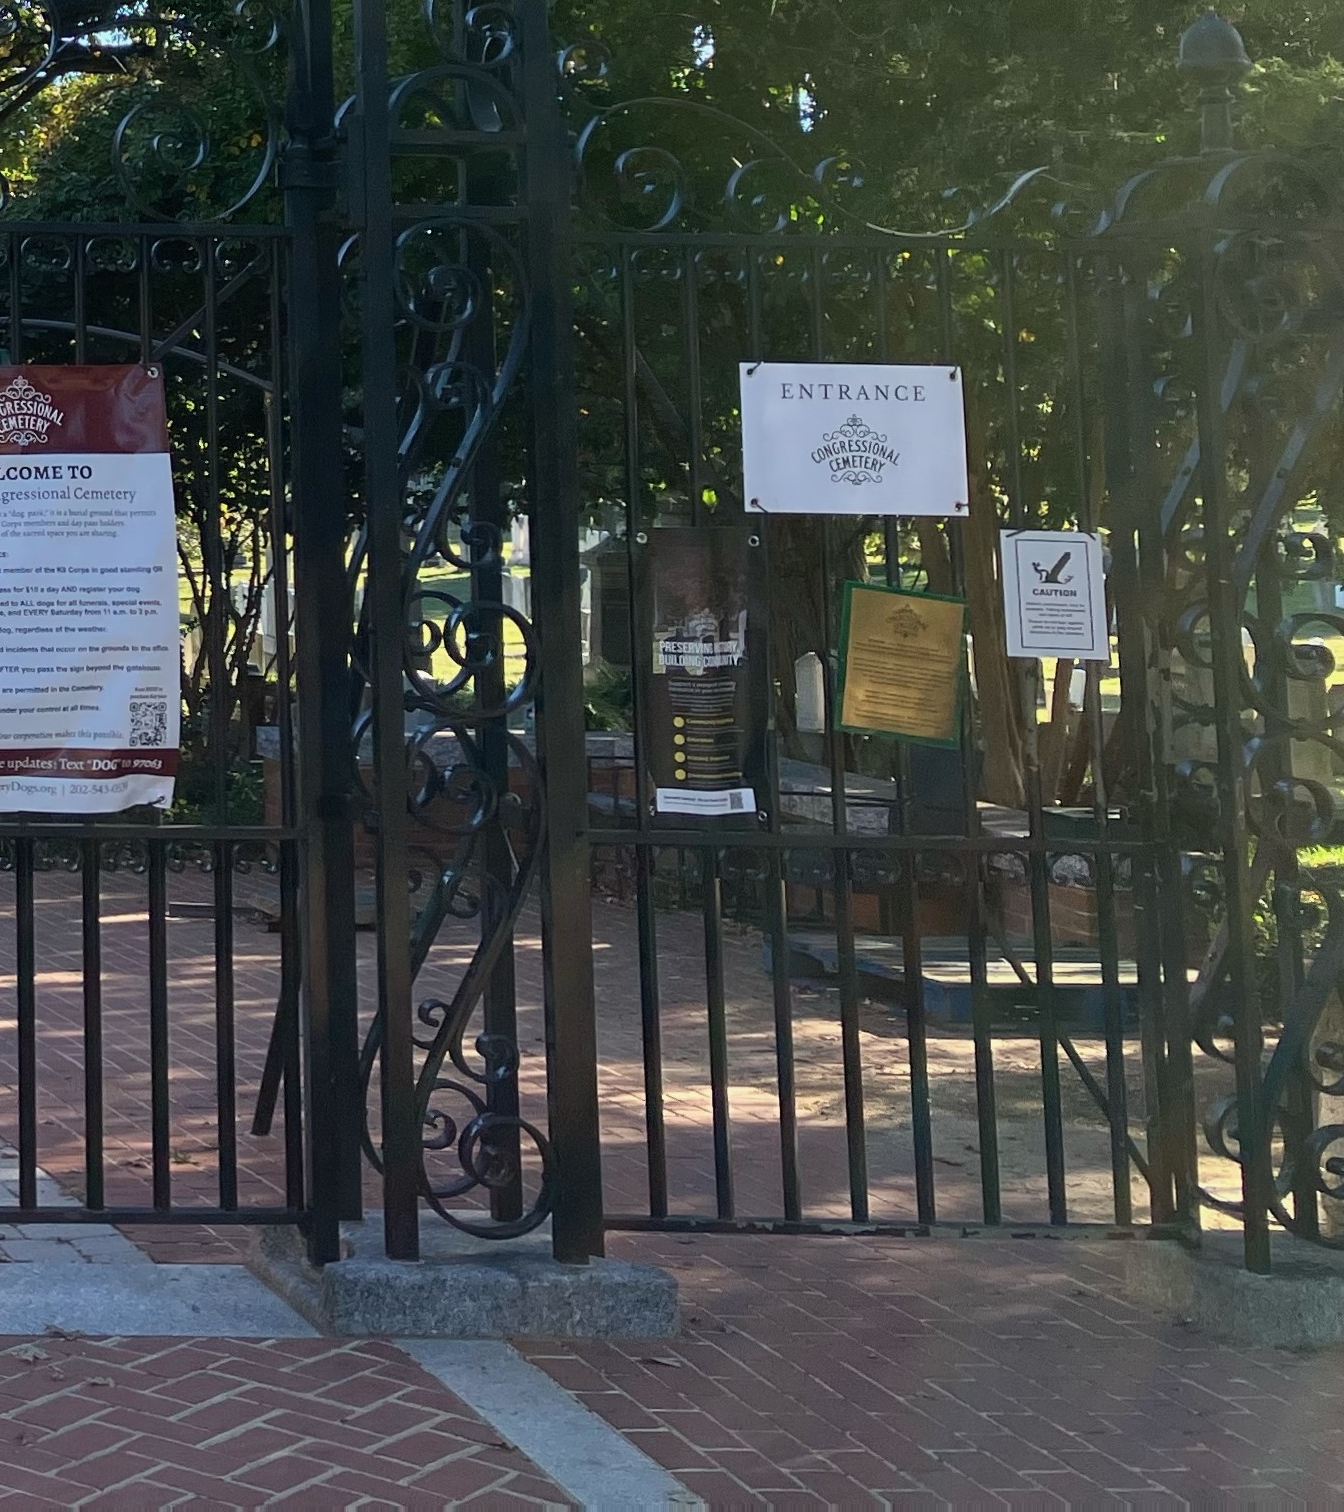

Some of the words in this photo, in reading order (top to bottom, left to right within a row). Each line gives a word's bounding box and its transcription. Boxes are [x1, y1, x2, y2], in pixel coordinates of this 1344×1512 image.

[780, 382, 926, 402] ENTRANCE
[810, 439, 901, 466] CONGRESSIONAL
[828, 454, 886, 473] CEMETERY
[73, 486, 137, 504] Cemetery
[46, 586, 60, 595] day
[79, 586, 106, 594] register
[108, 586, 125, 594] your
[1032, 588, 1077, 598] CAUTION
[36, 600, 55, 608] dogs
[56, 599, 67, 607] for
[68, 599, 77, 607] all
[111, 599, 137, 608] special
[23, 609, 49, 617] EVERY
[50, 609, 83, 617] Saturday
[15, 626, 53, 635] regardless
[58, 758, 85, 771] Text
[122, 758, 130, 767] to
[132, 759, 163, 769] 97063
